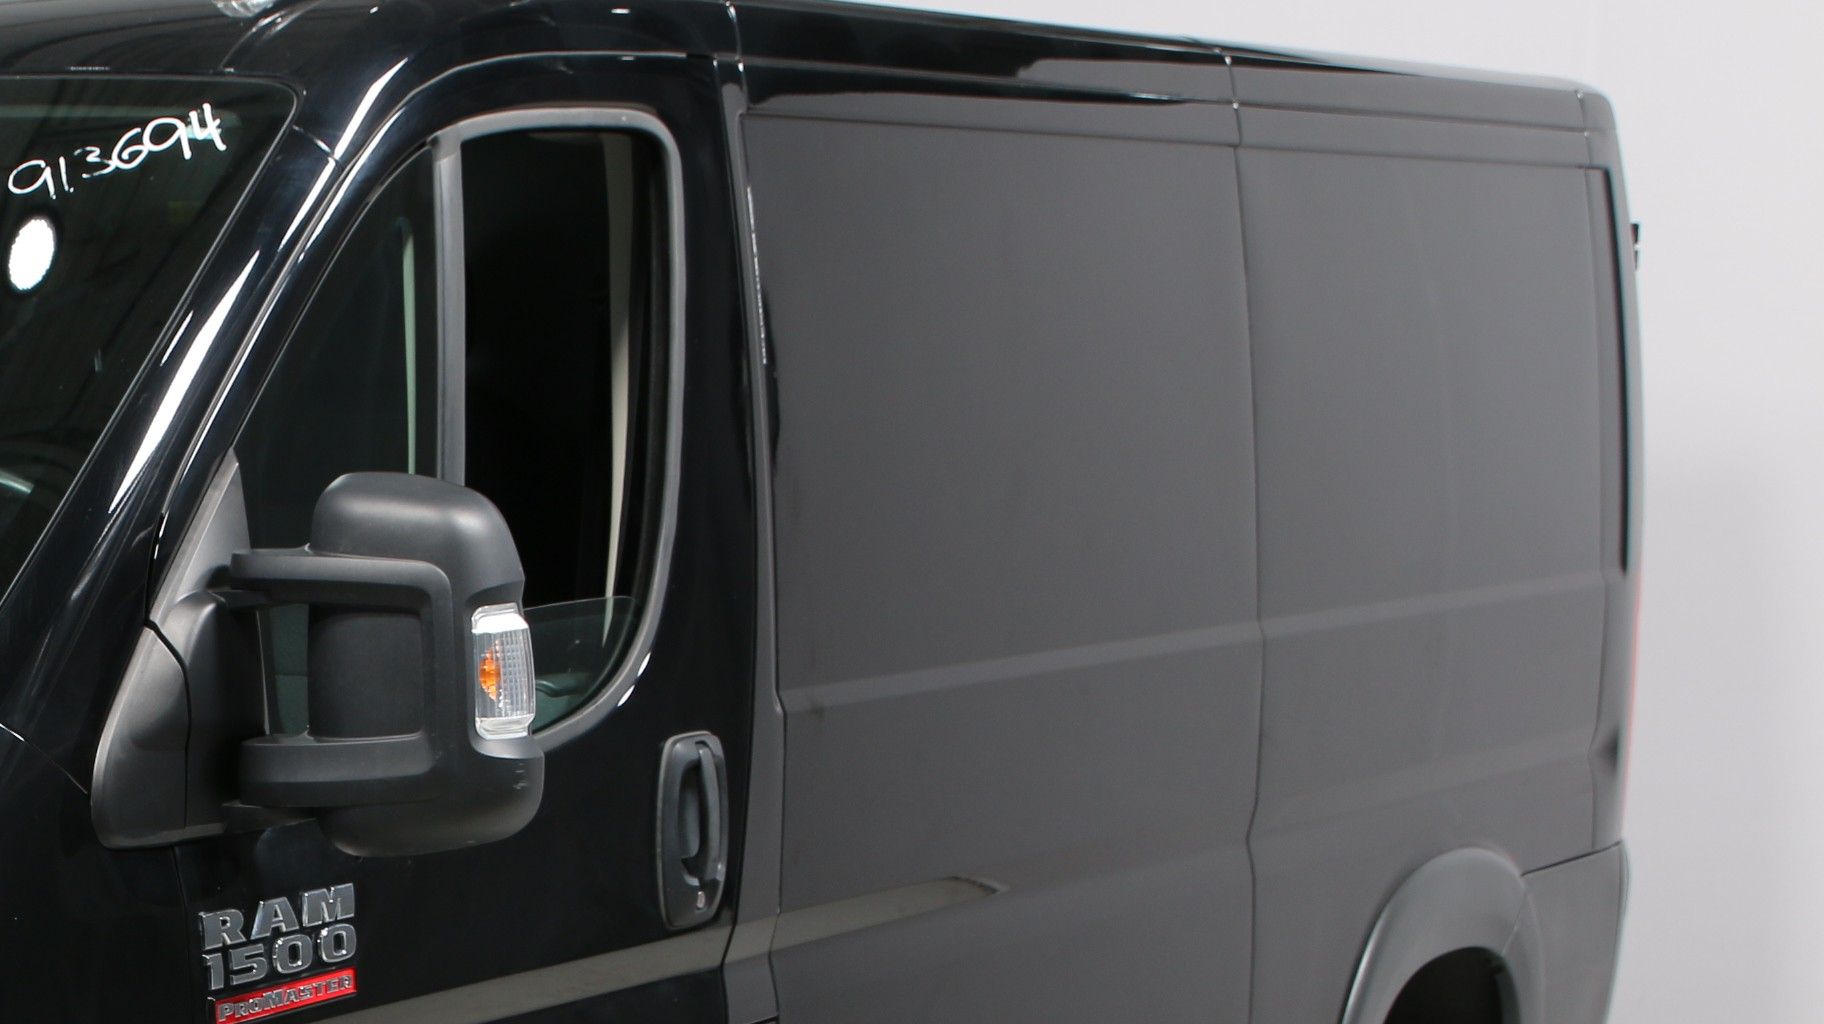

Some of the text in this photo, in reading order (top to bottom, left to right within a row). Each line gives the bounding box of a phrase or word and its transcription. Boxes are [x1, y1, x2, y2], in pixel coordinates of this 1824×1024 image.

[8, 103, 226, 199] 913694
[199, 882, 356, 950] RAM
[202, 923, 357, 990] 1500
